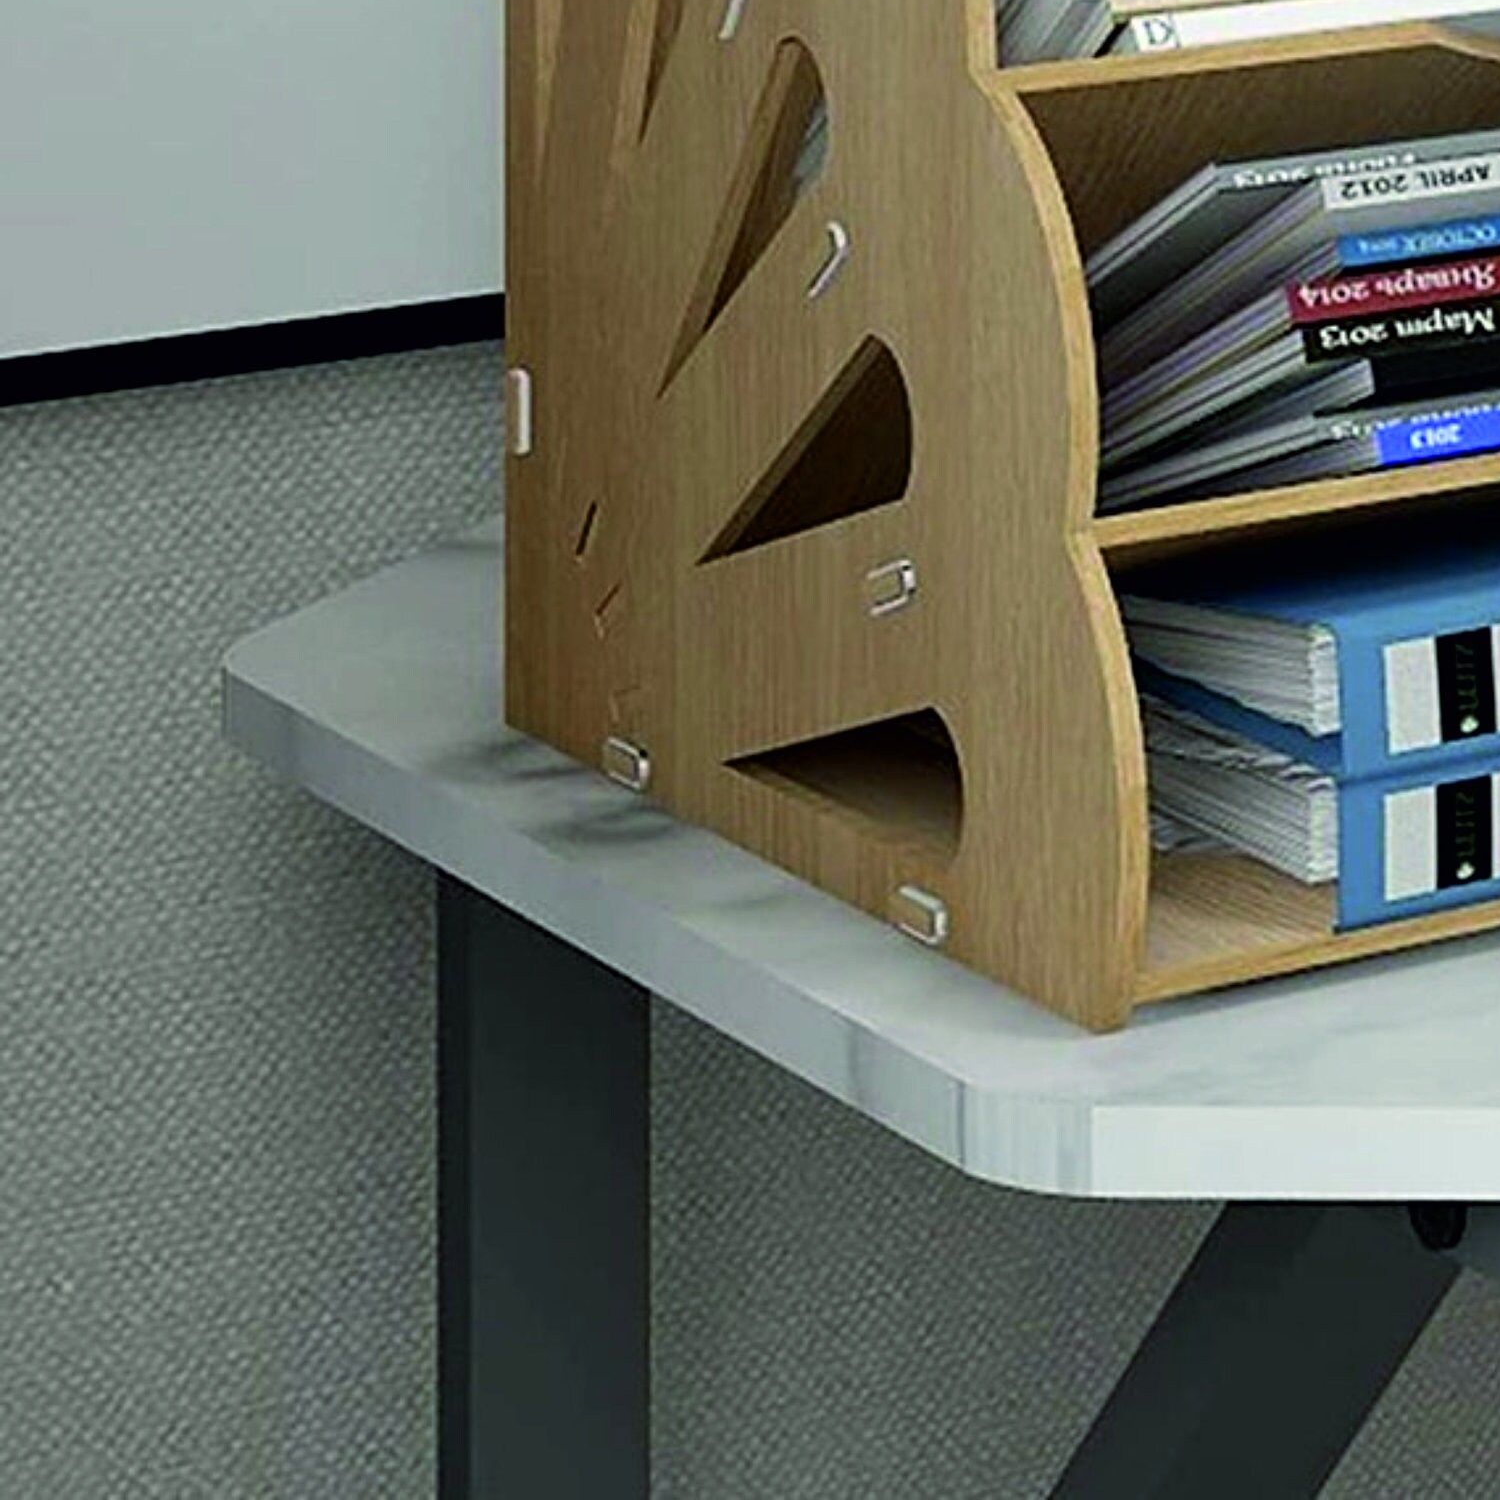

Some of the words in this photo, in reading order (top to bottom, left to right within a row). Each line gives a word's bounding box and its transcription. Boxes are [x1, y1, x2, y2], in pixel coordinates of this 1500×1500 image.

[1341, 173, 1409, 200] 2012
[1418, 163, 1491, 189] APRIL
[1299, 281, 1371, 310] 2014
[1319, 322, 1389, 350] 2013
[1409, 423, 1462, 449] 2013
